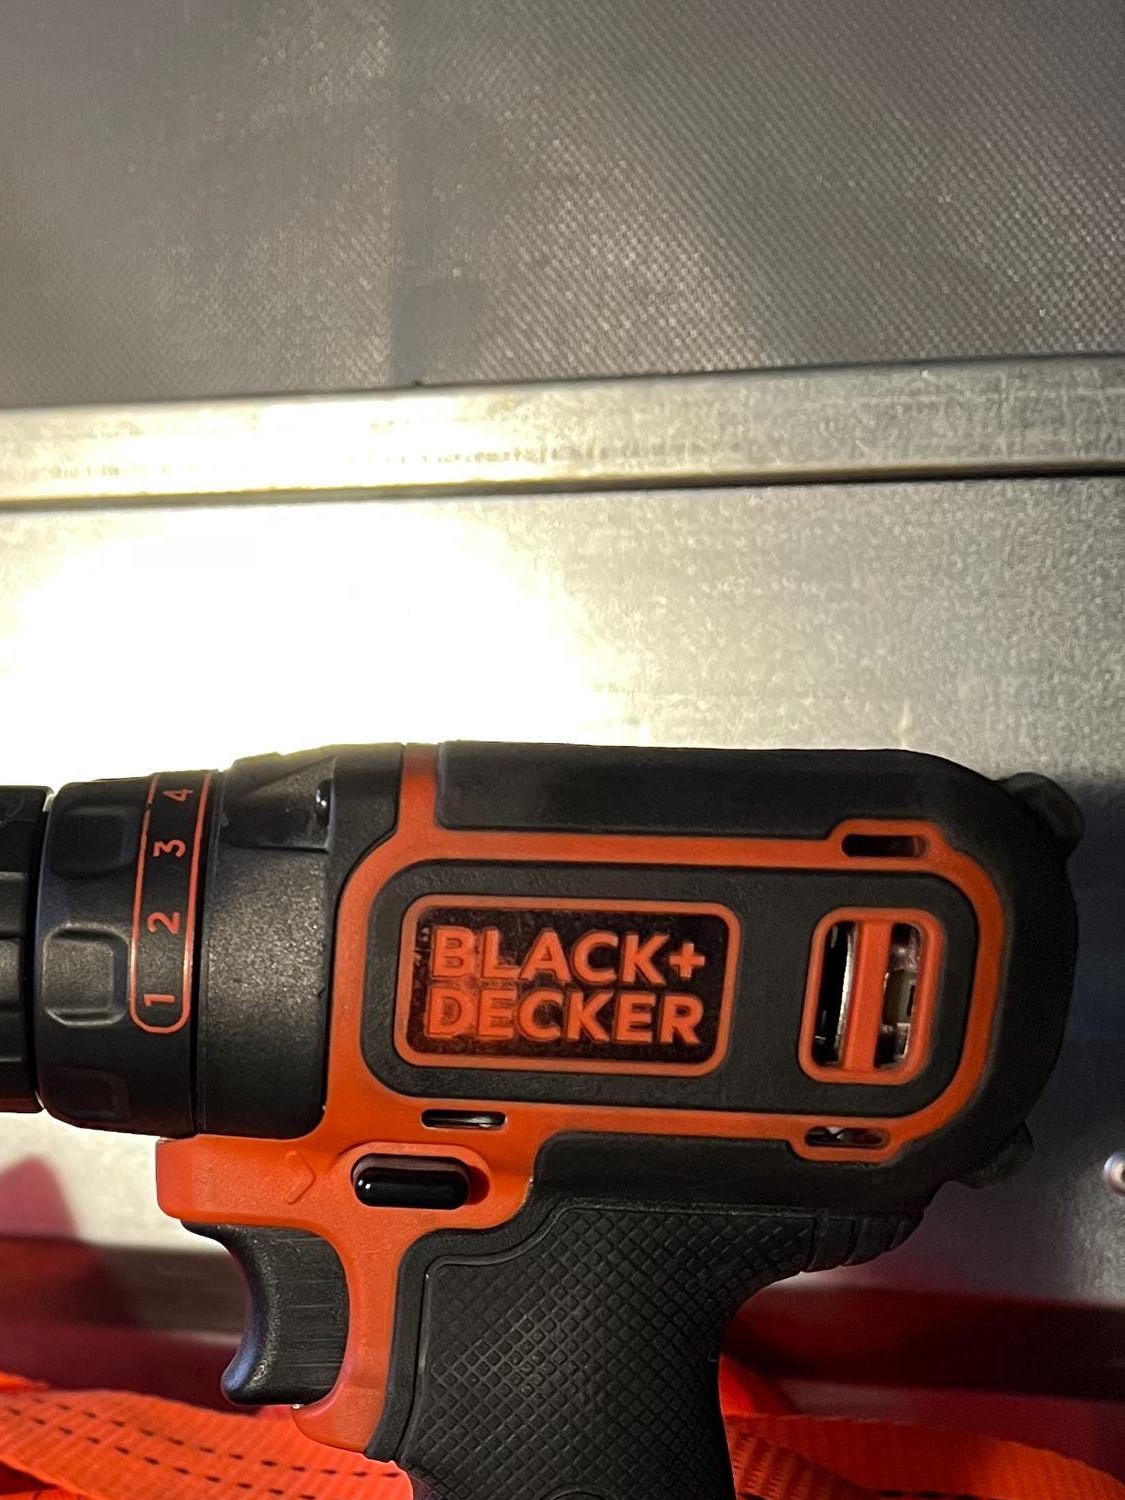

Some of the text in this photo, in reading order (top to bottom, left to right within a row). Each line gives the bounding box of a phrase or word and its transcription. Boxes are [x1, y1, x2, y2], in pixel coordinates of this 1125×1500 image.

[143, 788, 194, 1007] 1 2 3 4
[432, 926, 706, 986] BLACK+
[426, 987, 705, 1044] DECKER
